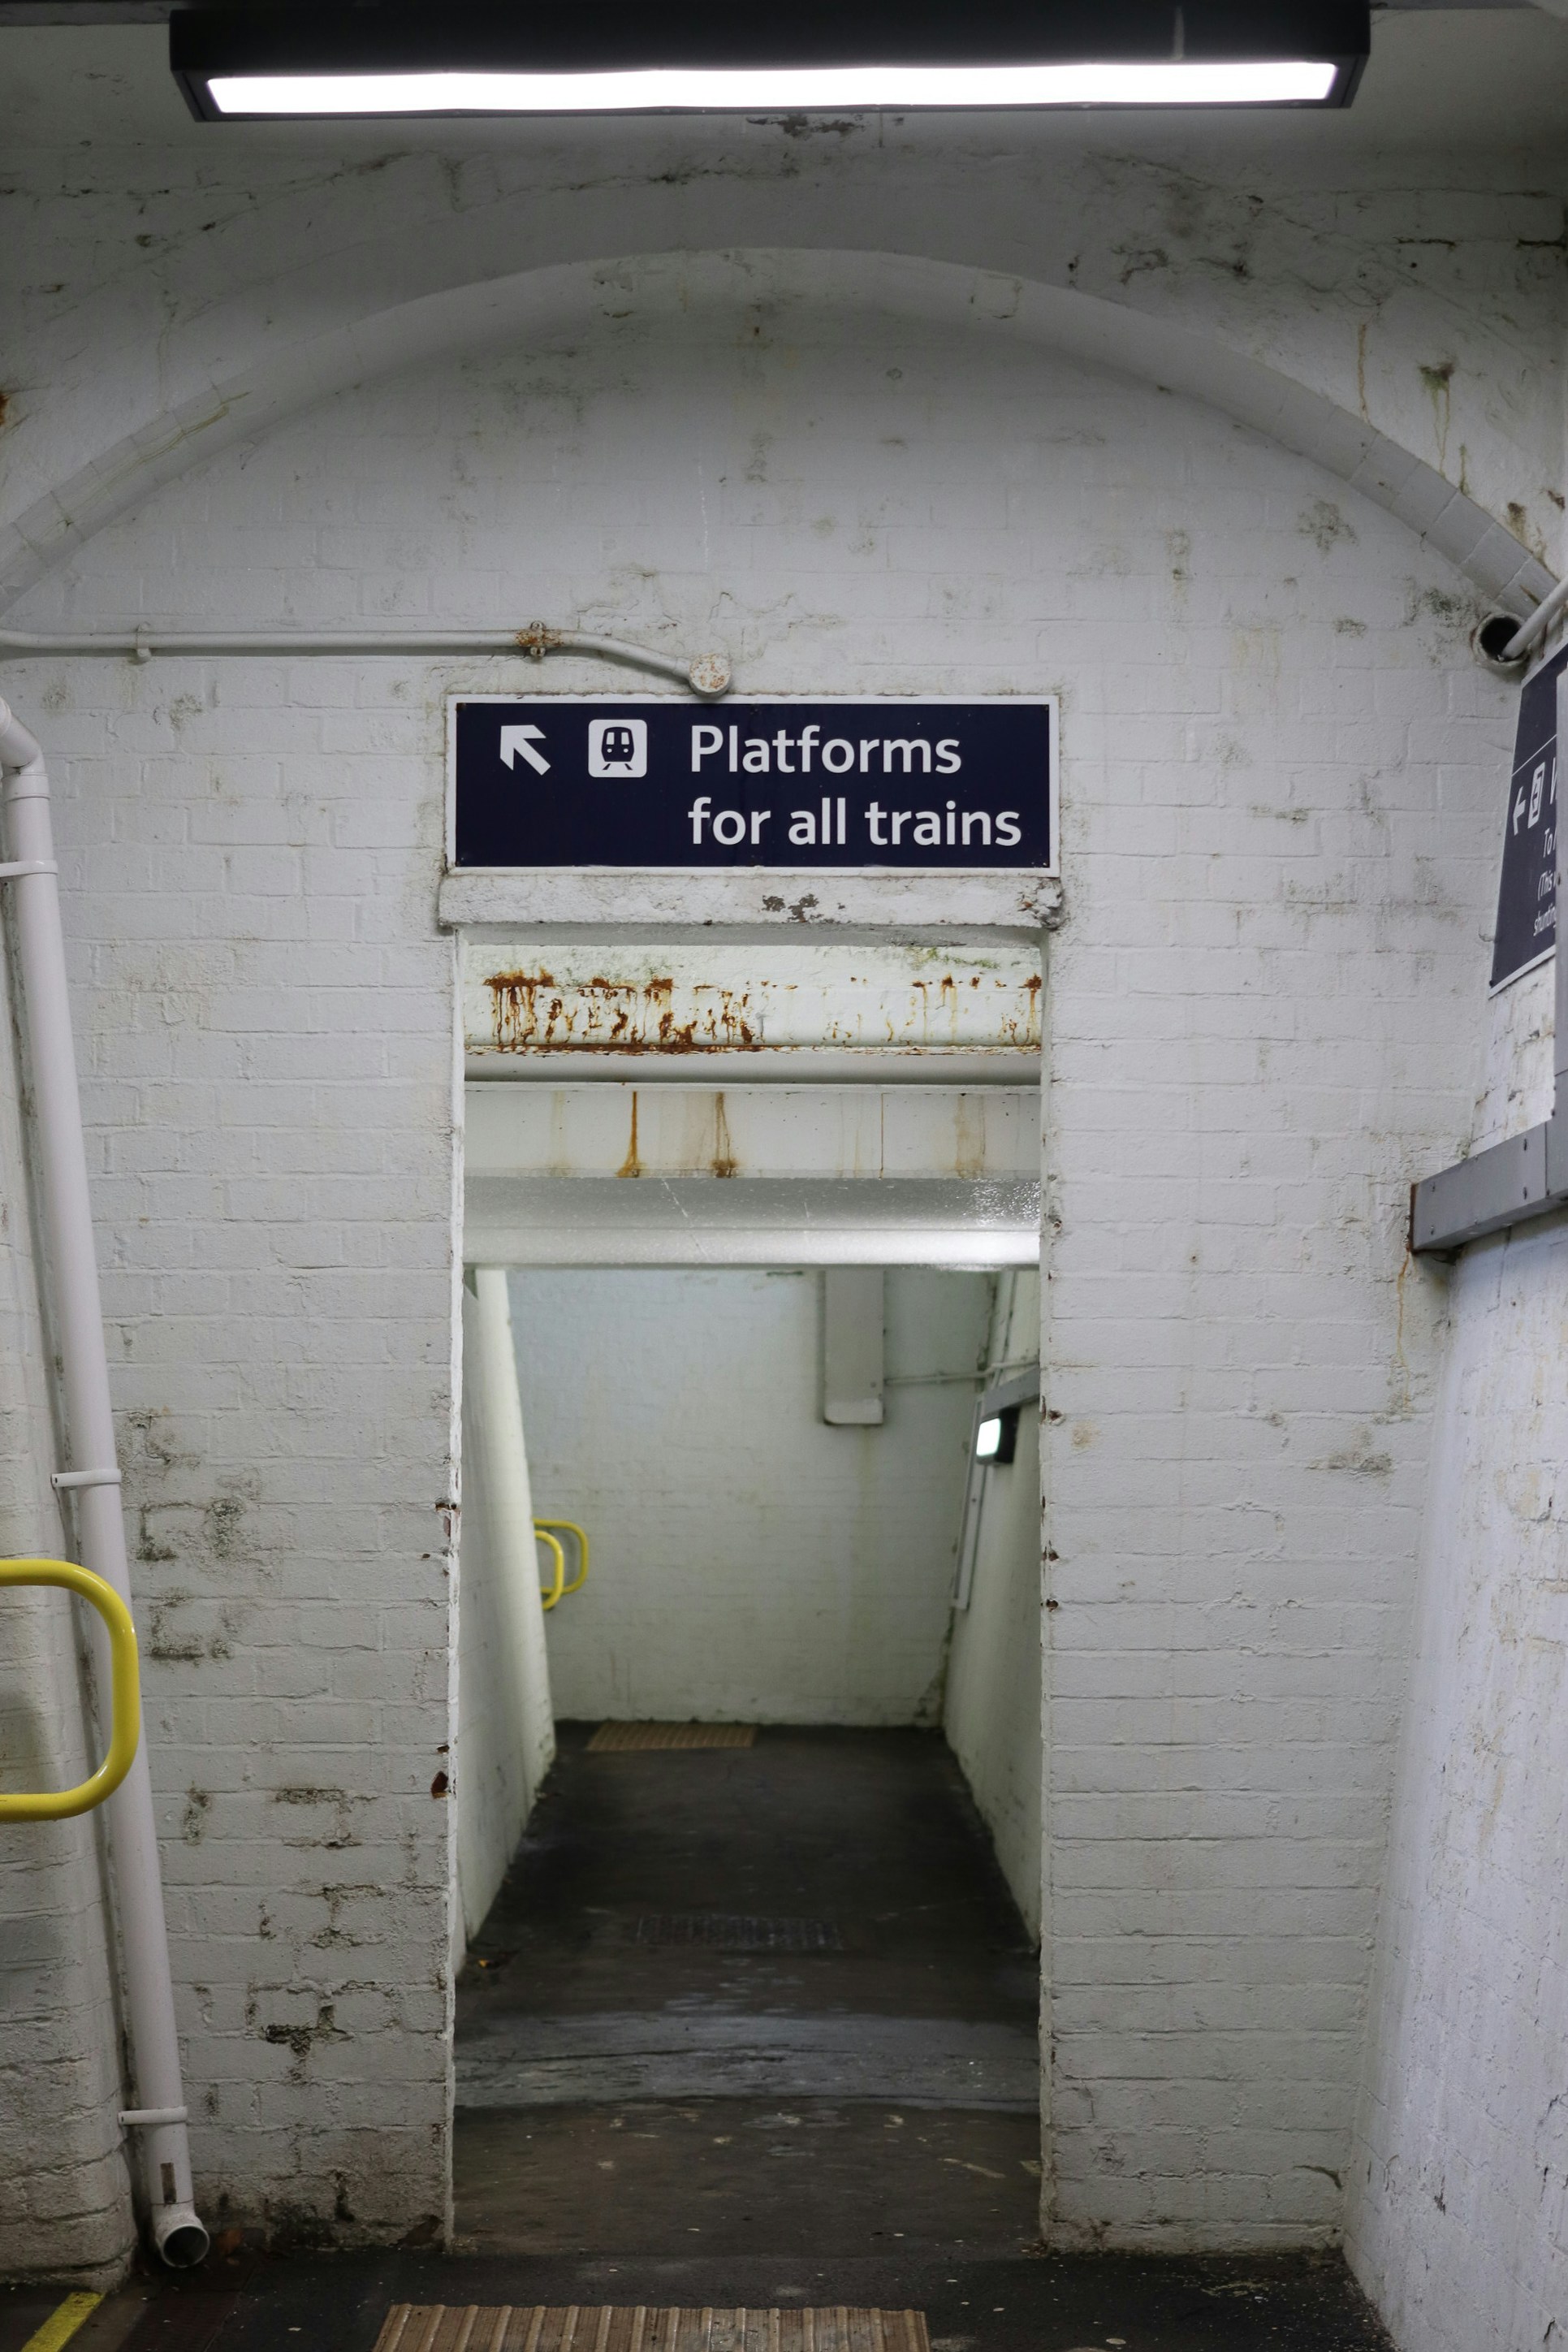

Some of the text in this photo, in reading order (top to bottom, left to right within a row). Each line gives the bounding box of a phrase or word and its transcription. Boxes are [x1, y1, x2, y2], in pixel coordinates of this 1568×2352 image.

[691, 724, 961, 774] Platforms
[688, 796, 1022, 846] for all trains
[1543, 828, 1553, 858] To
